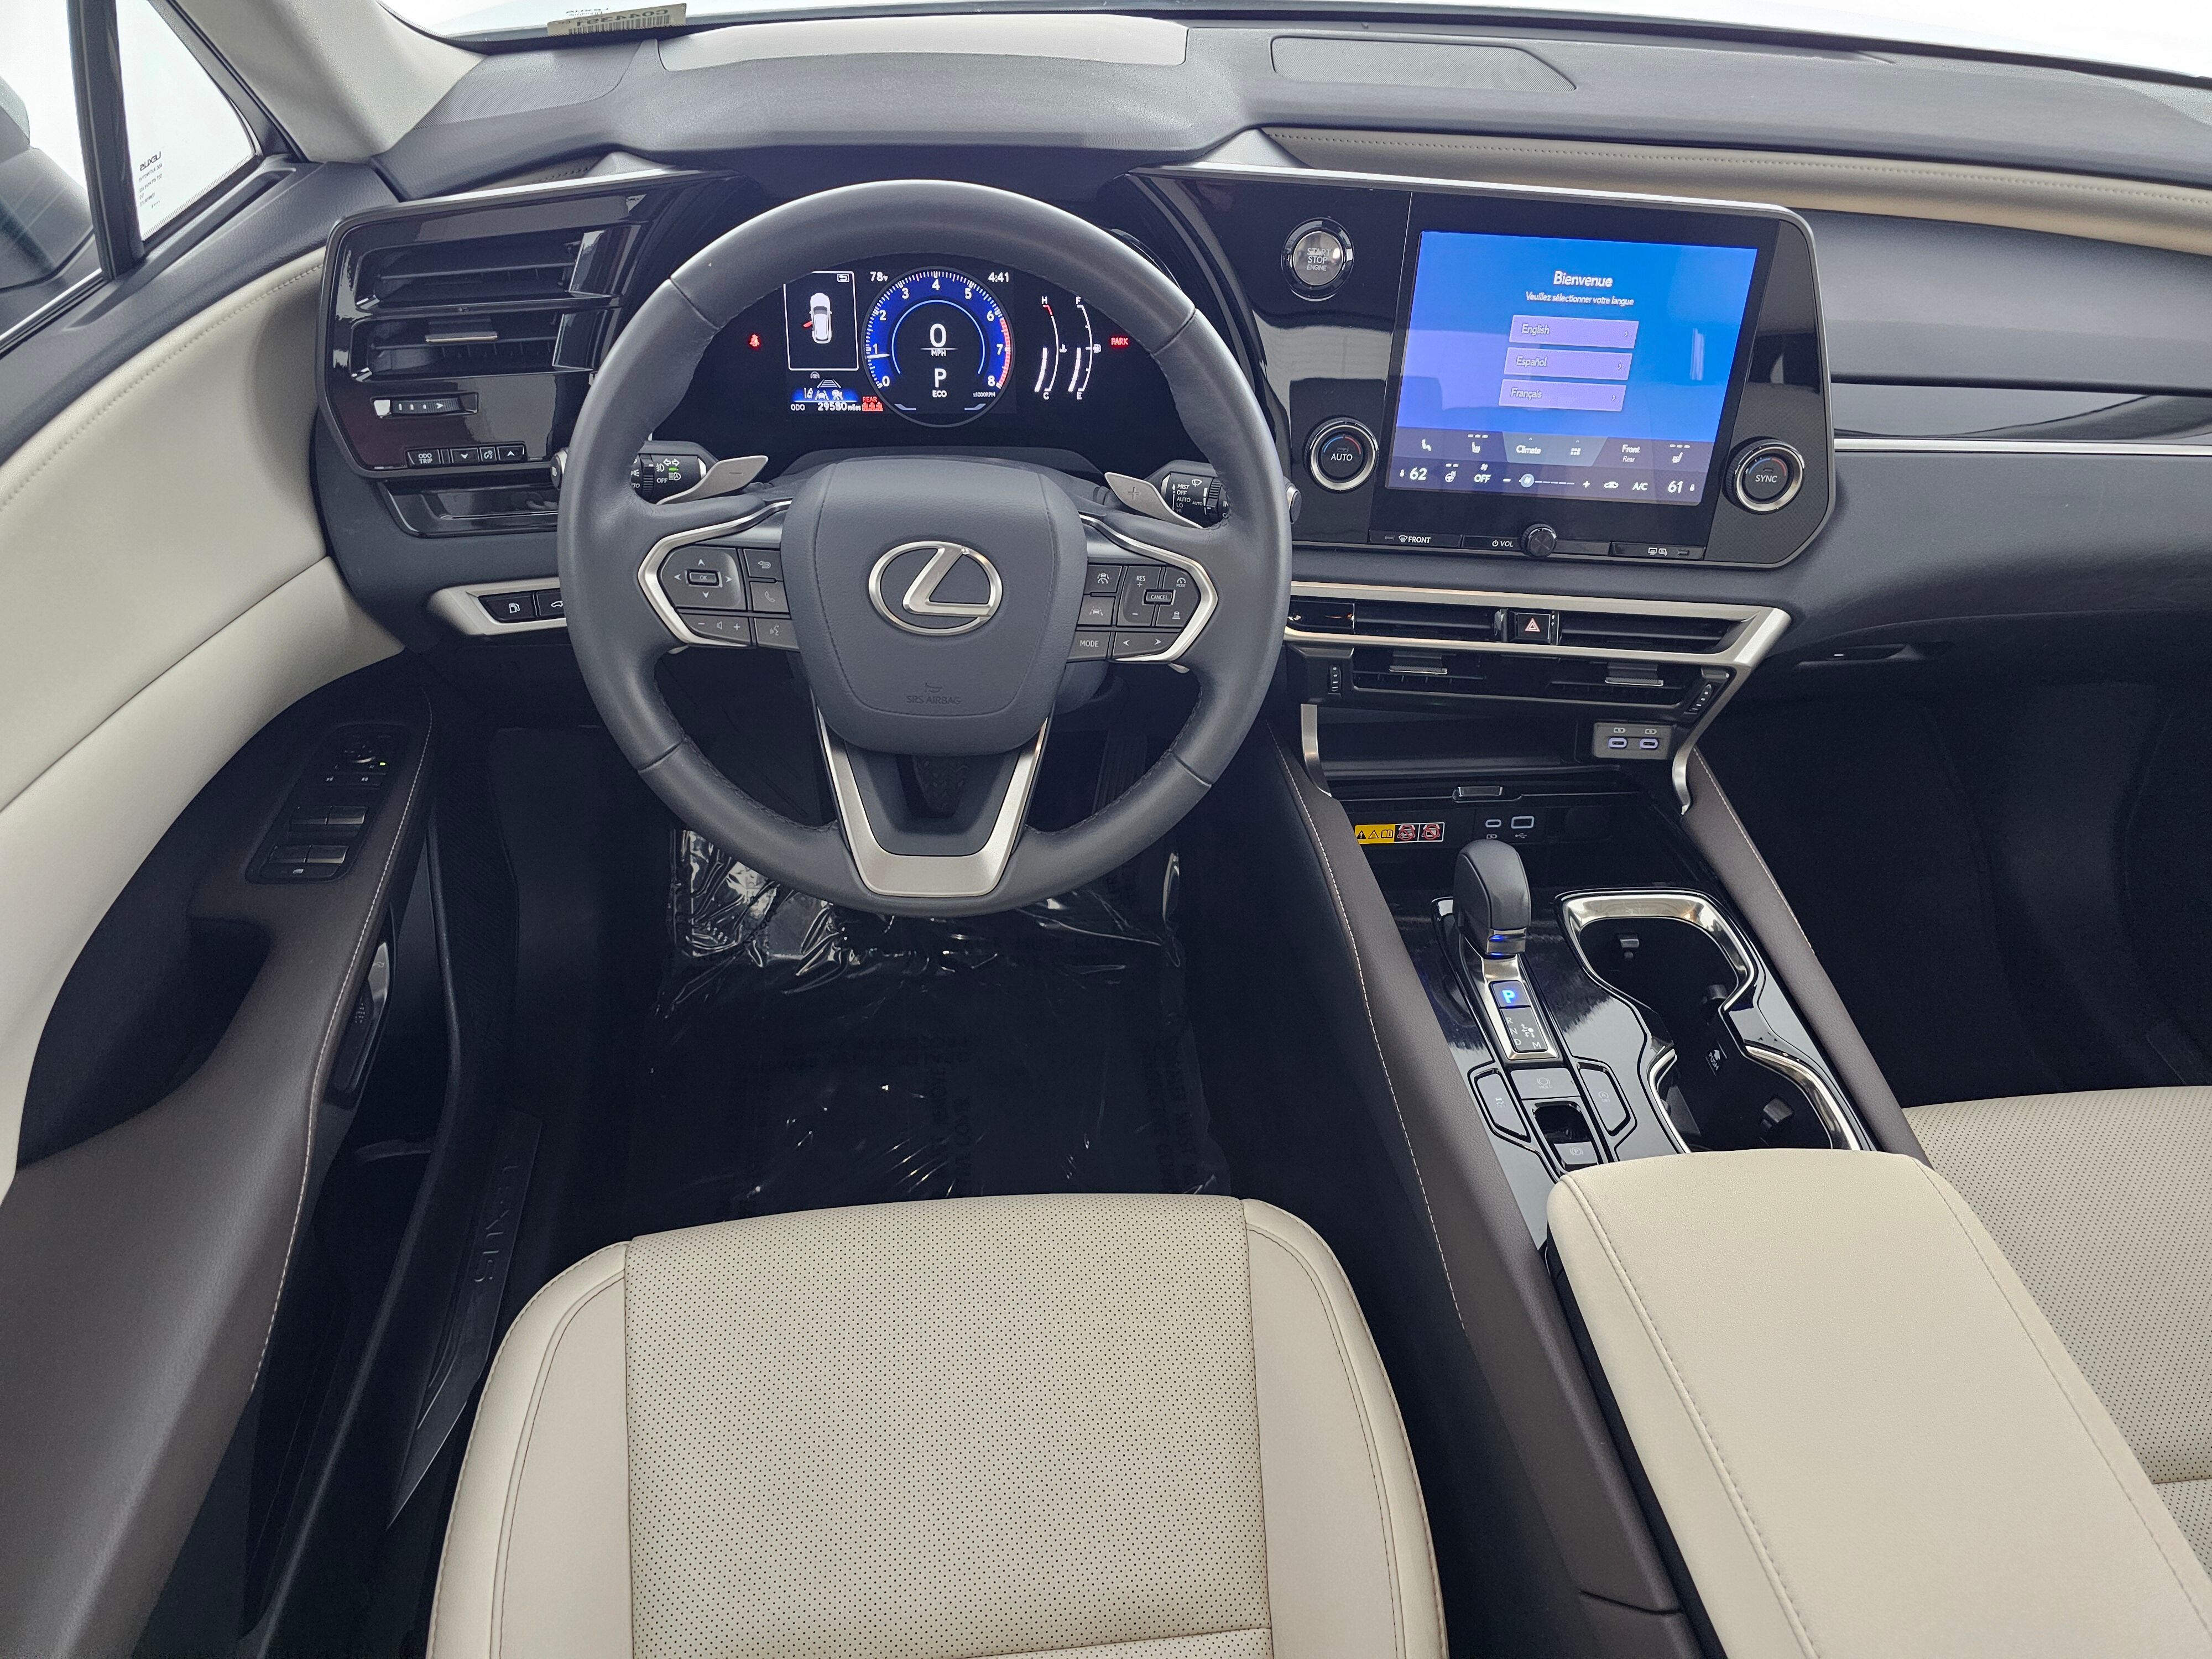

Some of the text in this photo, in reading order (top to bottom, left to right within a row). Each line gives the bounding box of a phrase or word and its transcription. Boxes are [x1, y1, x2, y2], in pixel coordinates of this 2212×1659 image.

[1307, 248, 1331, 256] START
[988, 272, 1009, 283] 4:41
[1553, 270, 1614, 288] Bienvenue
[932, 279, 940, 290] 4
[902, 288, 909, 299] 3
[964, 288, 972, 299] 5
[1526, 291, 1552, 301] Veuillez
[1552, 293, 1593, 304] sélectionner
[1611, 296, 1635, 307] langue
[879, 310, 886, 321] 2
[987, 310, 995, 321] 6
[1521, 324, 1550, 336] English
[873, 343, 878, 354] 1
[997, 343, 1004, 355] 7
[1516, 356, 1547, 367] Español
[881, 375, 890, 387] 0
[934, 368, 947, 388] P
[988, 375, 995, 387] 8
[1510, 387, 1542, 400] Français
[817, 402, 847, 411] 29580
[1516, 445, 1542, 455] Climate
[1621, 444, 1641, 453] Front
[1331, 453, 1353, 461] AUTO
[1410, 467, 1427, 481] 62
[1474, 474, 1491, 483] OFF
[1755, 474, 1777, 483] SYNC
[1632, 482, 1648, 491] A/C
[1668, 481, 1683, 493] 61
[906, 695, 962, 705] SRS AIRBAG
[1502, 990, 1515, 1003] P
